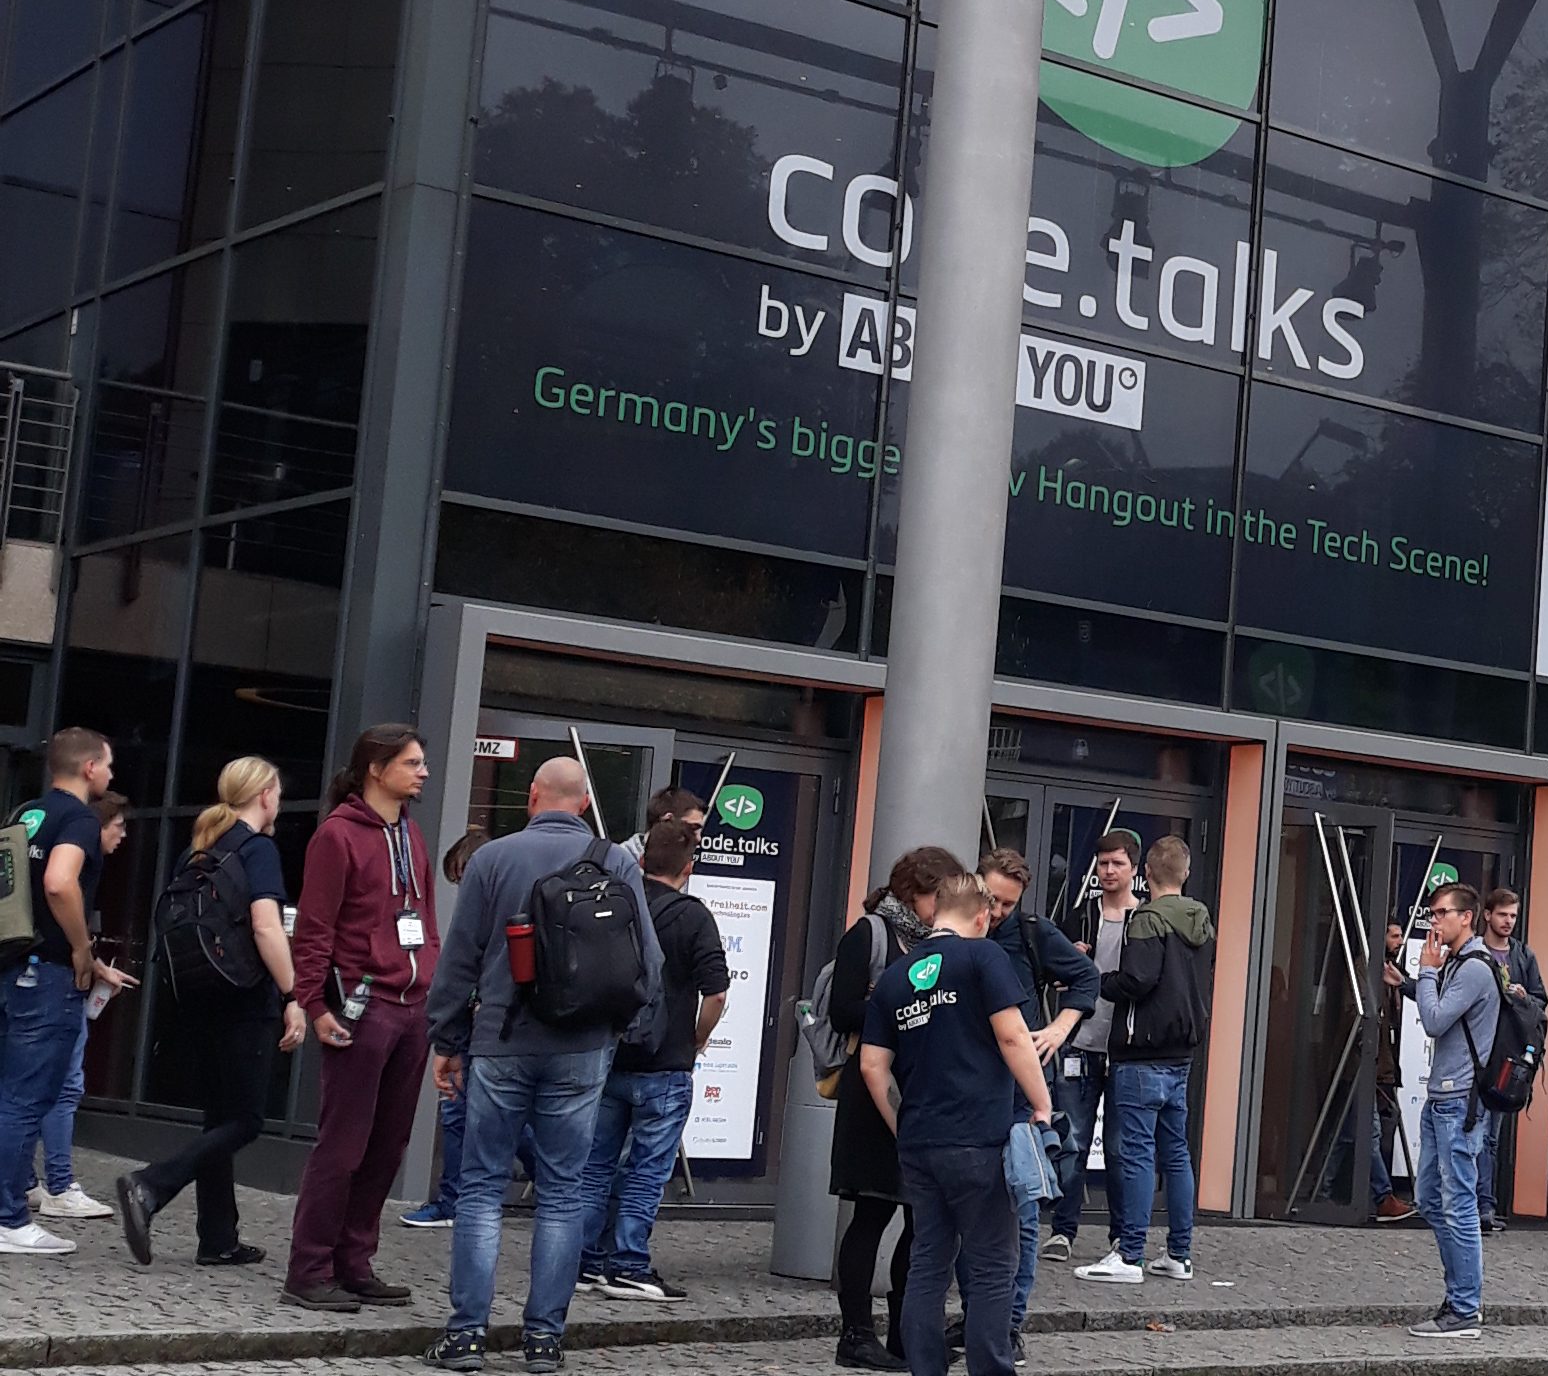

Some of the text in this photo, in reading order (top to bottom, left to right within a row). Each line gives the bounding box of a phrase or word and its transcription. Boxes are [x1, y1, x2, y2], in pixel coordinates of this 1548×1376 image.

[768, 154, 1366, 380] coe.talks
[757, 284, 826, 356] by
[534, 366, 901, 478] Germany's bigge
[1037, 465, 1196, 531] Hangout
[1206, 499, 1235, 538] in
[1243, 509, 1297, 551] the
[1307, 520, 1379, 565] Tech
[1390, 536, 1490, 586] Scene!
[701, 833, 779, 856] ode.talks
[710, 899, 768, 912] freiheit.com
